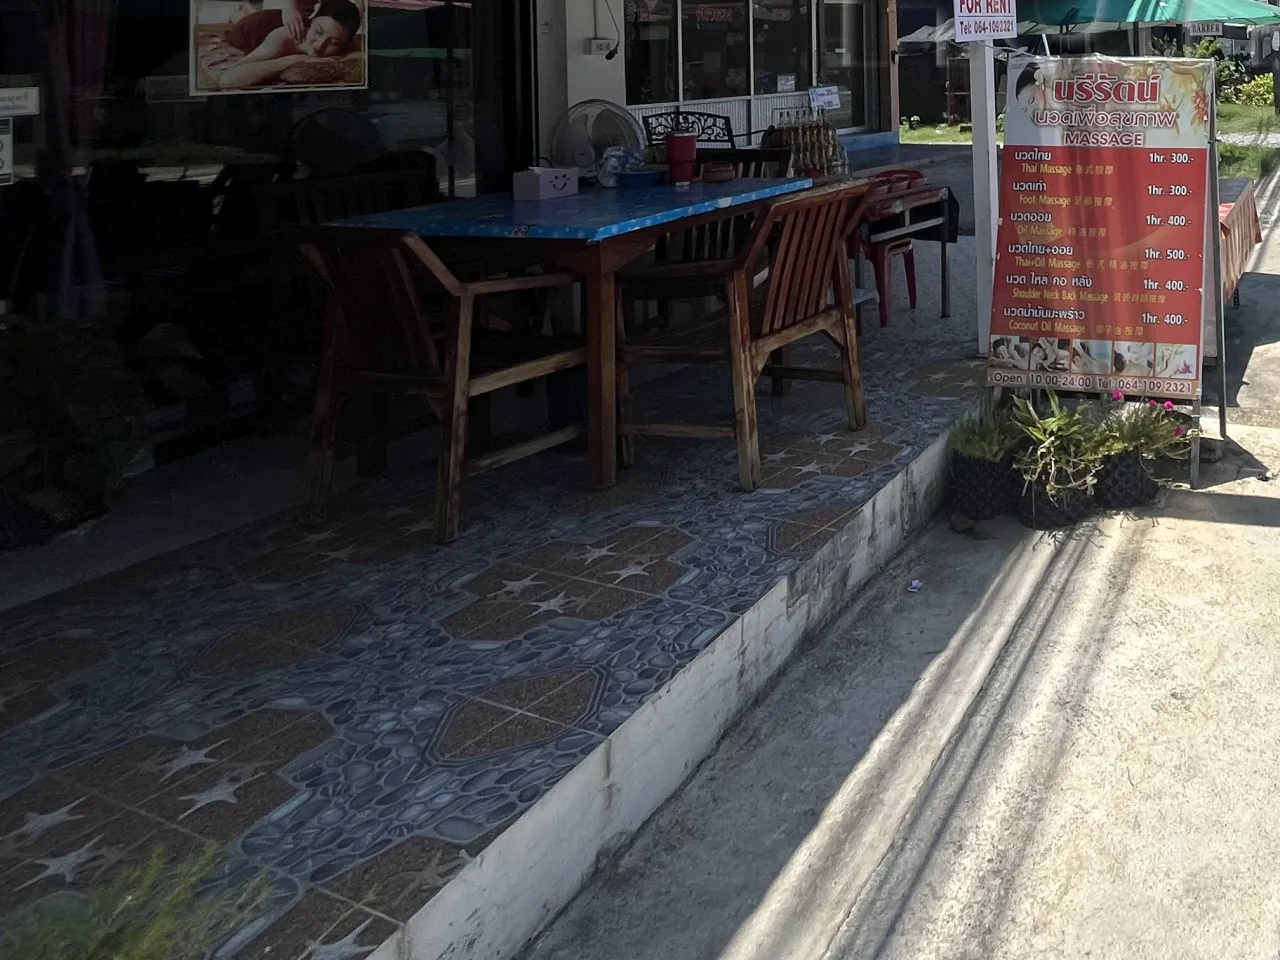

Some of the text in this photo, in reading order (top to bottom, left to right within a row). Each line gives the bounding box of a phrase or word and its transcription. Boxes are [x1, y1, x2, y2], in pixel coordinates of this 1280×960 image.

[1192, 23, 1220, 33] BARBER
[1053, 73, 1162, 103] นรีรัตน์
[1034, 104, 1177, 130] นวดเพื่อสุขภาพ
[1064, 132, 1143, 146] MASSAGE
[1015, 148, 1052, 161] นวดไทย
[1149, 153, 1167, 163] 1hr.
[1021, 163, 1072, 176] Thai Massage
[1147, 185, 1165, 195] 1hr.
[1019, 194, 1071, 208] Foot Massage
[1146, 215, 1164, 225] 1hr.
[1017, 225, 1063, 237] Oil Massage
[1144, 249, 1162, 259] 1hr.
[1048, 257, 1081, 271] Massage
[1006, 274, 1026, 284] นวด
[1052, 276, 1067, 286] คอ
[1071, 274, 1092, 287] หลัง
[1143, 279, 1161, 290] 1hr.
[1012, 287, 1109, 304] Shoulder Neck Back Massage
[1003, 303, 1085, 320] นวดน้ำมันมะพร้าว
[1142, 313, 1160, 324] 1hr.
[1009, 320, 1086, 335] Coconut Oil Massage
